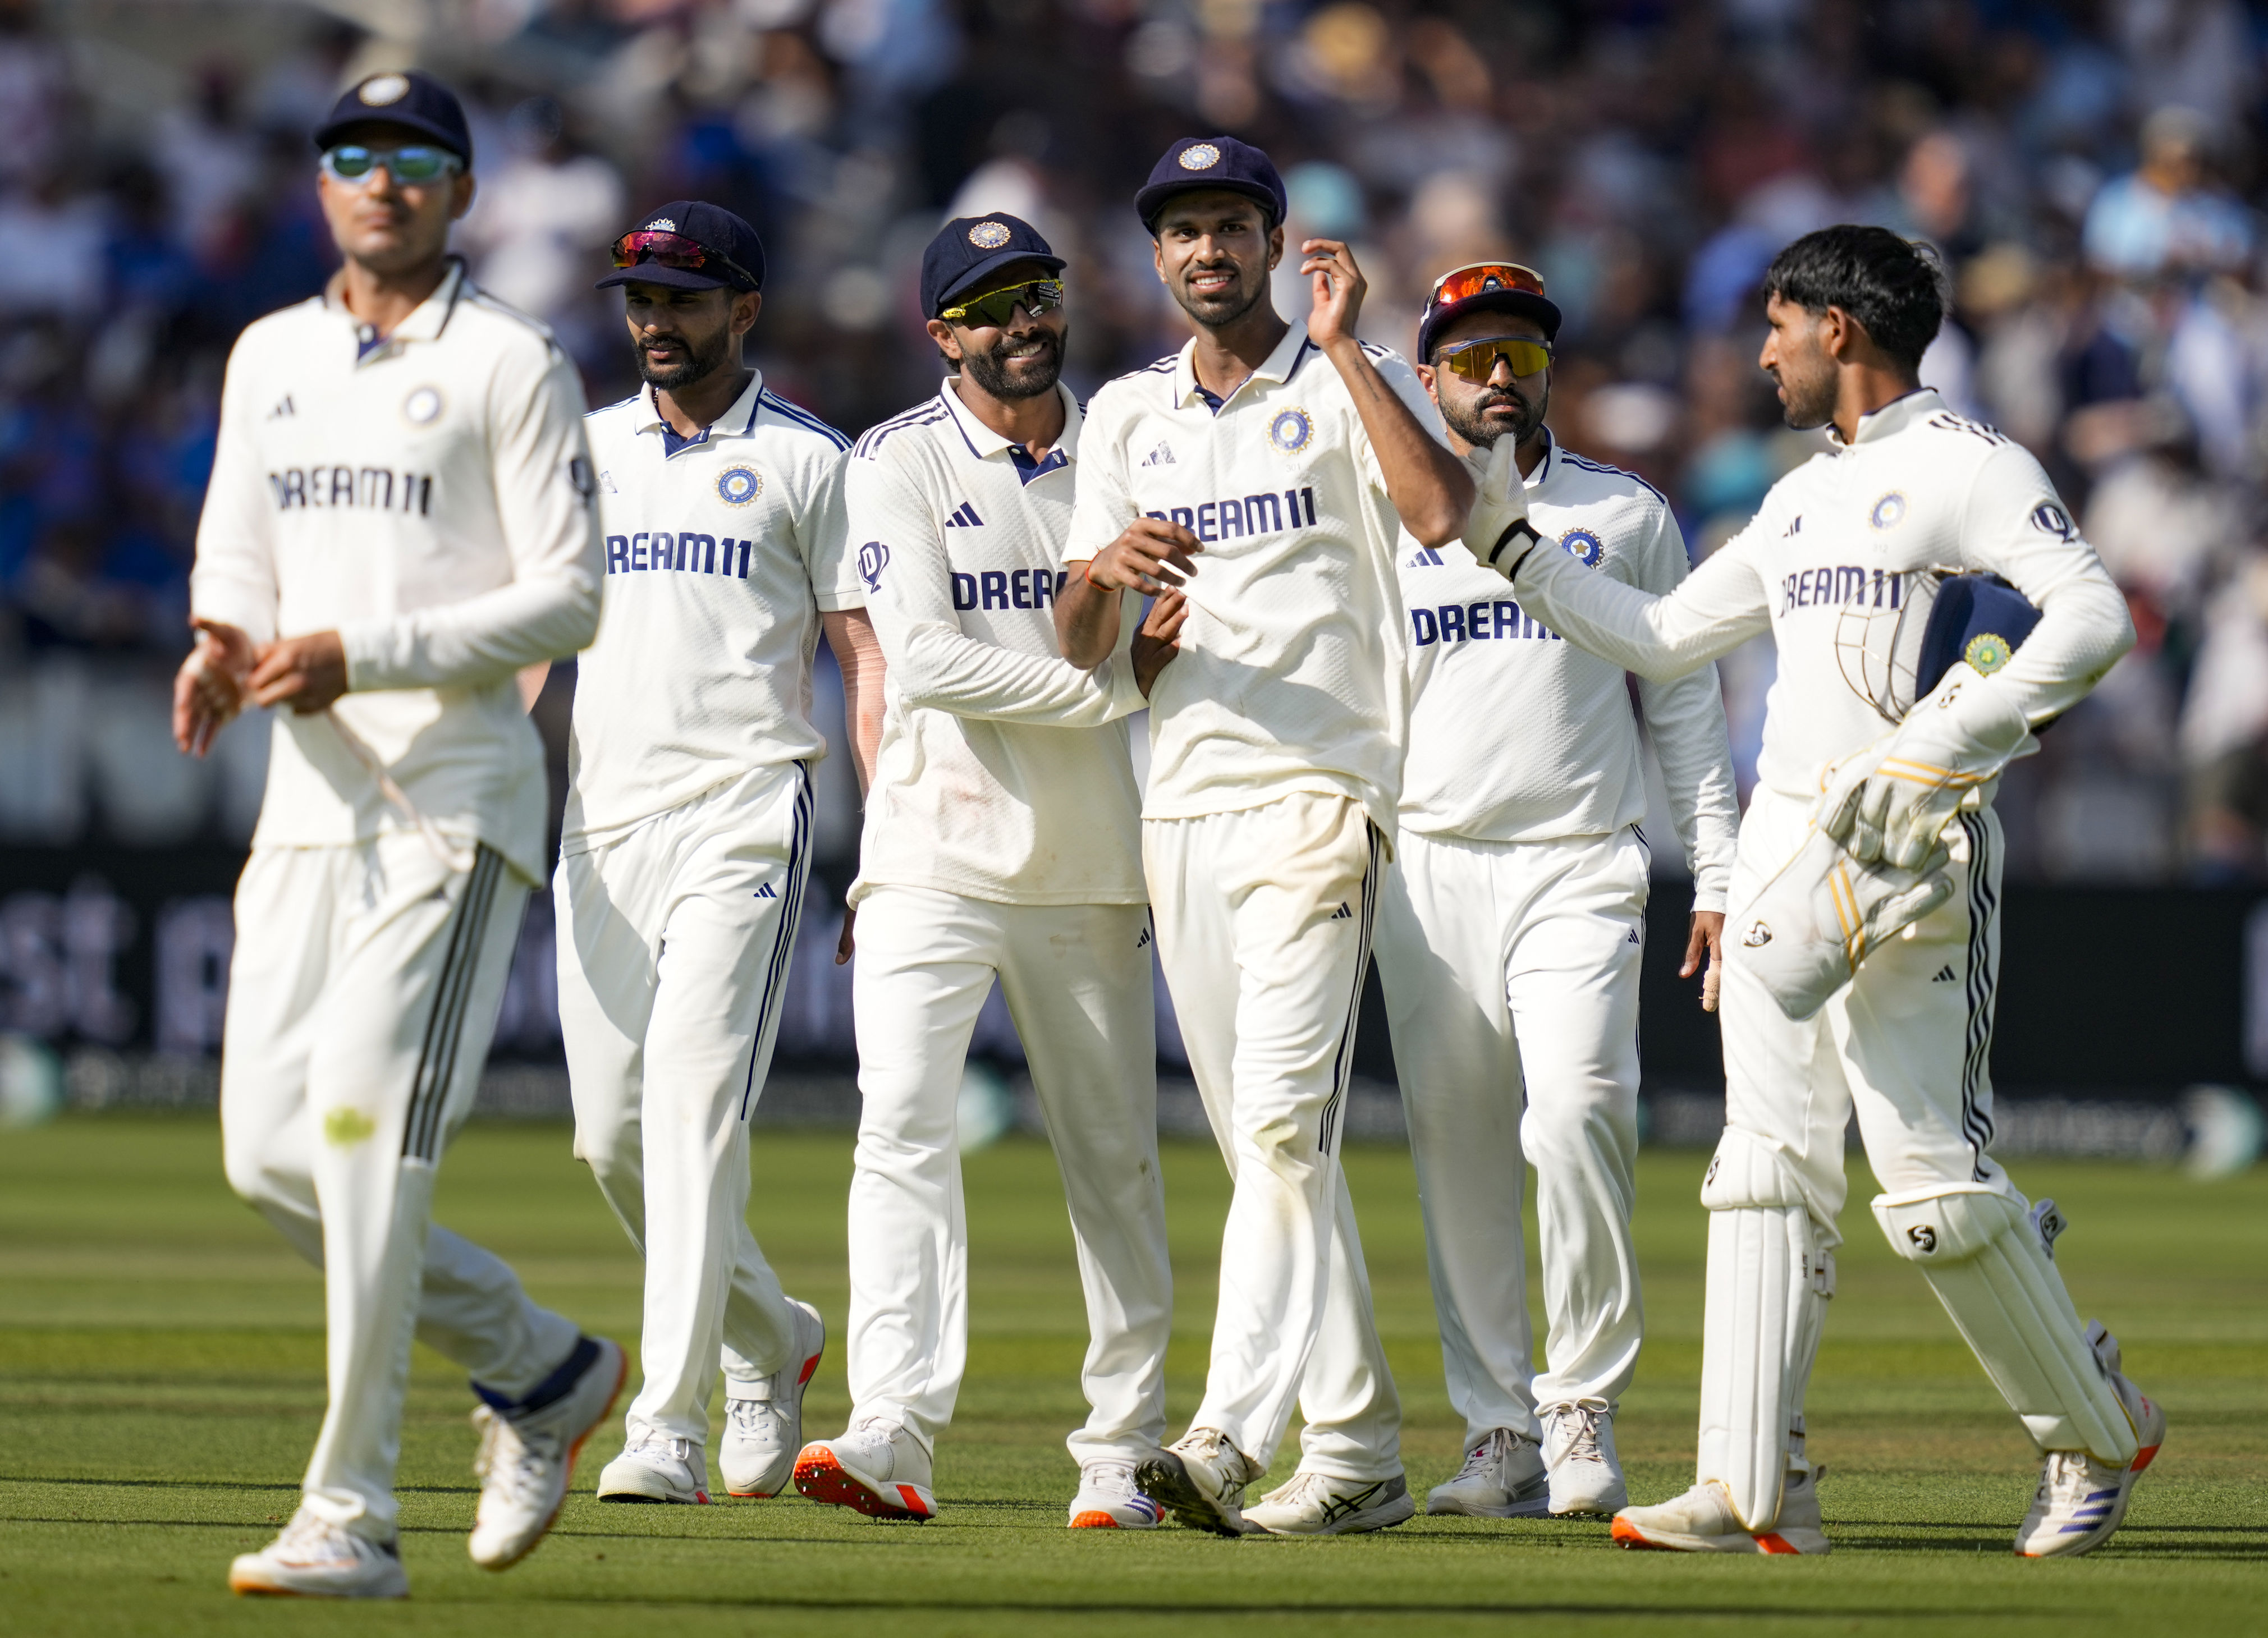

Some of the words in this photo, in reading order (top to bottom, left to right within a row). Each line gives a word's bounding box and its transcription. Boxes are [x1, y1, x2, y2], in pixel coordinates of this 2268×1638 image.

[1286, 462, 1301, 472] 301
[604, 532, 752, 579] REAM11
[950, 569, 1068, 611] DREA
[1780, 565, 1901, 618] REAM11
